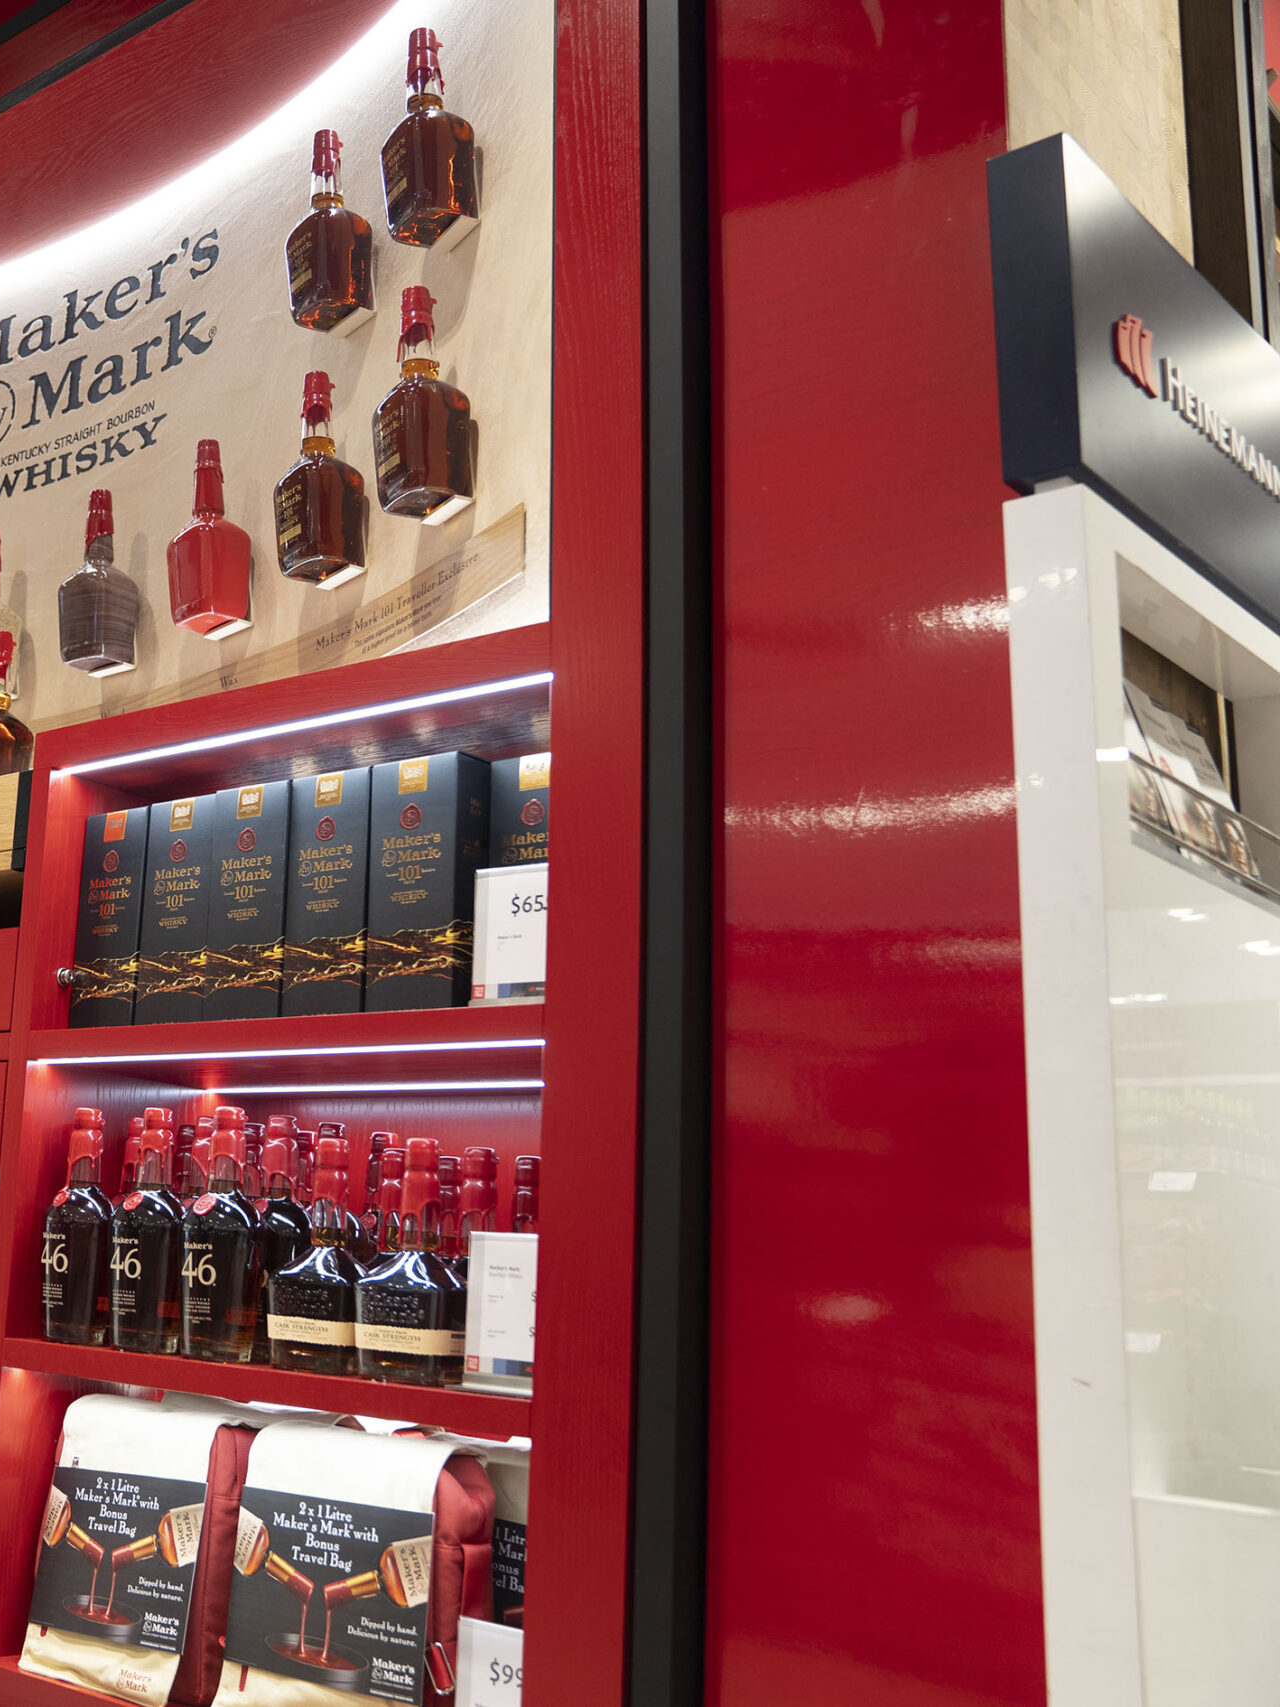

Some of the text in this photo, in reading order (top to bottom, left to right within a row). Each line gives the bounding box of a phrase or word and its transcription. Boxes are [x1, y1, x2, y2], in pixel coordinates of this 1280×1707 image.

[22, 310, 212, 429] Mark
[0, 401, 155, 467] KENTUCKY STRAIGHT BOURBON
[315, 625, 352, 650] Maker's
[354, 612, 378, 632] Mark
[381, 603, 394, 619] 101
[396, 582, 435, 610] Traveller
[220, 675, 238, 690] Wax
[382, 832, 441, 850] Maker's
[299, 843, 353, 860] Maker's
[398, 846, 441, 863] Mark
[222, 855, 272, 870] Maker's
[312, 859, 352, 873] Mark
[154, 866, 201, 881] Maker's
[234, 868, 272, 883] Mark
[398, 865, 421, 881] 101
[89, 875, 132, 889] Maker's
[165, 878, 200, 892] Mark
[312, 876, 335, 891] 101
[100, 888, 131, 900] Mark
[165, 894, 184, 908] 101
[234, 885, 255, 900] 101
[99, 903, 115, 917] 101
[41, 1242, 68, 1275] 46
[110, 1246, 141, 1281] 46
[181, 1251, 217, 1288] 46
[292, 1324, 329, 1333] STRENGTH
[382, 1333, 421, 1342] STRENGTH
[96, 1477, 102, 1489] 2
[111, 1478, 116, 1491] 1
[117, 1479, 140, 1494] Litre
[75, 1487, 111, 1504] Maker's
[139, 1496, 160, 1511] with
[99, 1505, 128, 1520] Bonus
[299, 1502, 352, 1522] 2 x 1 Litre
[88, 1517, 137, 1538] Travel Bag
[273, 1512, 318, 1531] Maker's
[352, 1526, 379, 1543] with
[306, 1533, 340, 1551] Bonus
[504, 1528, 526, 1545] Litr
[291, 1546, 352, 1572] Travel Bag
[499, 1542, 527, 1561] Mar
[408, 1546, 420, 1581] Mark
[492, 1562, 519, 1575] onus
[400, 1547, 415, 1598] Maker's
[138, 1576, 184, 1592] Dipped by hand.
[509, 1576, 524, 1593] Ba
[127, 1585, 183, 1602] Delicious by nature.
[144, 1612, 179, 1626] Maker's
[361, 1616, 418, 1635] Dipped by hand.
[152, 1623, 177, 1636] Mark
[347, 1625, 417, 1647] Delicious by nature.
[372, 1657, 415, 1674] Maker's
[120, 1669, 152, 1682] Maker's
[382, 1670, 415, 1686] Mark
[125, 1679, 148, 1693] Mark
